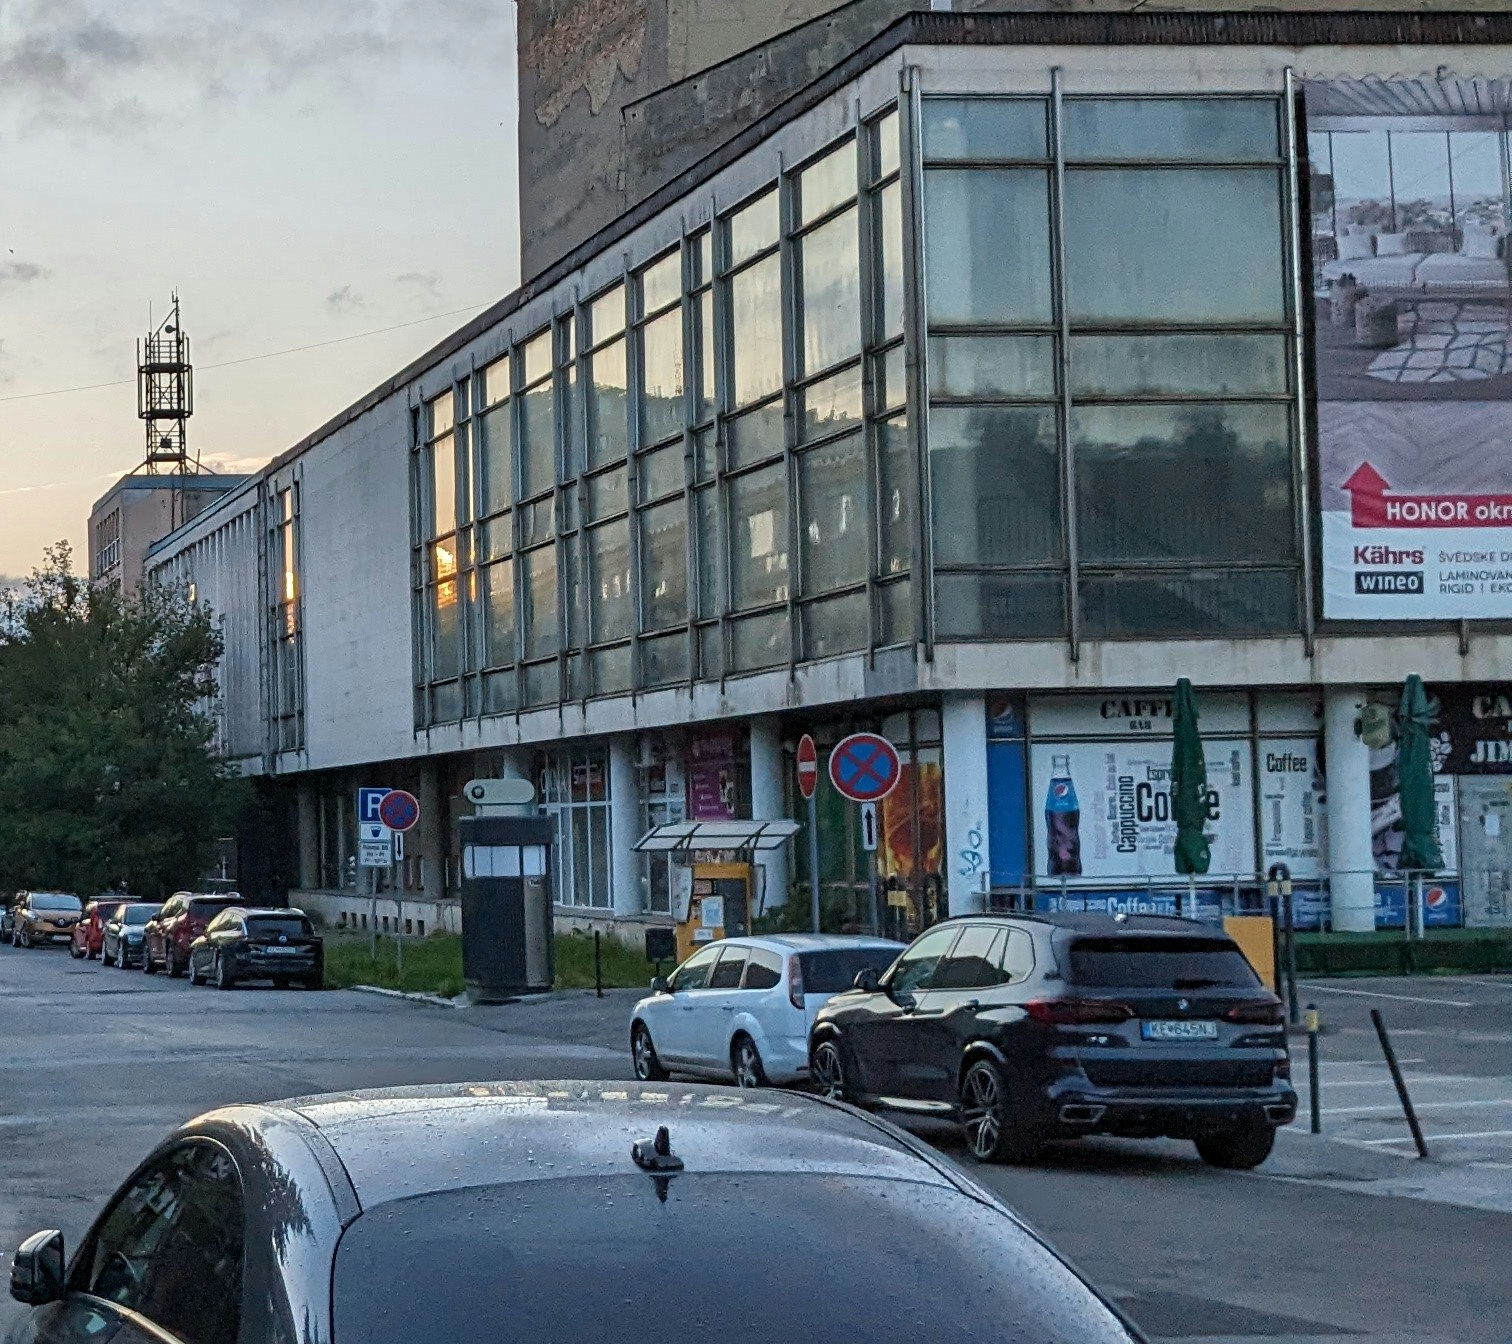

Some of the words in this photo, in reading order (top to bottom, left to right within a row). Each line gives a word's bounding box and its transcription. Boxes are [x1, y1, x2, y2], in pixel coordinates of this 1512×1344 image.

[1386, 501, 1468, 521] HONOR
[1353, 545, 1424, 565] Kährs
[1266, 753, 1308, 773] Coffee
[1116, 775, 1141, 853] Cappuccino
